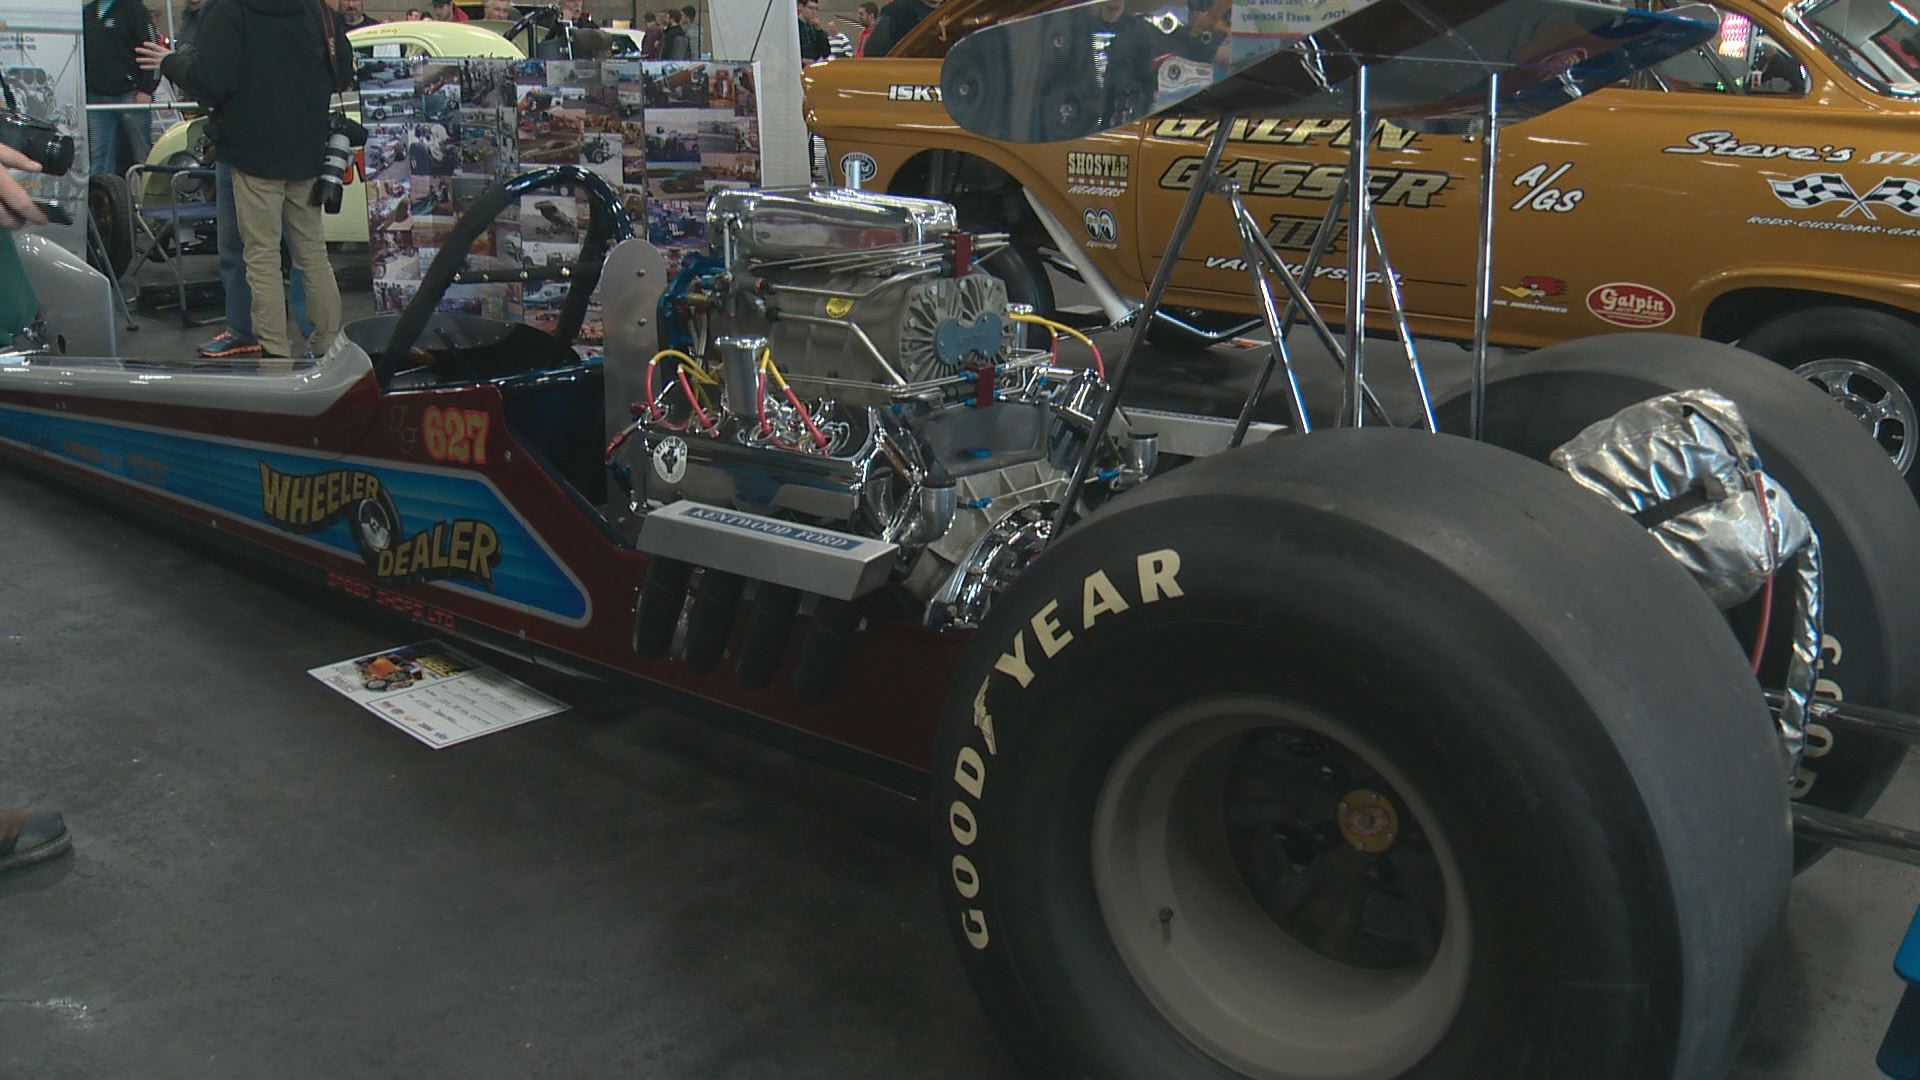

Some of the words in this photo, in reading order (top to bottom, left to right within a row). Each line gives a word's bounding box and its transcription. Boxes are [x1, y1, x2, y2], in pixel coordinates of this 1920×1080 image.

[1068, 152, 1128, 177] SHOSTLE
[1663, 129, 1856, 162] Steve's
[1159, 156, 1449, 208] GASSER
[1511, 161, 1584, 212] A/GS
[1747, 215, 1793, 226] RODS
[1798, 219, 1882, 234] CUSTOMS
[1600, 288, 1665, 313] Galpin
[423, 406, 489, 464] 627
[259, 461, 380, 525] WHEELER
[692, 506, 792, 536] KENTWOOD
[795, 529, 849, 548] FORD
[376, 518, 498, 581] DEALER
[375, 588, 424, 618] SHOPS
